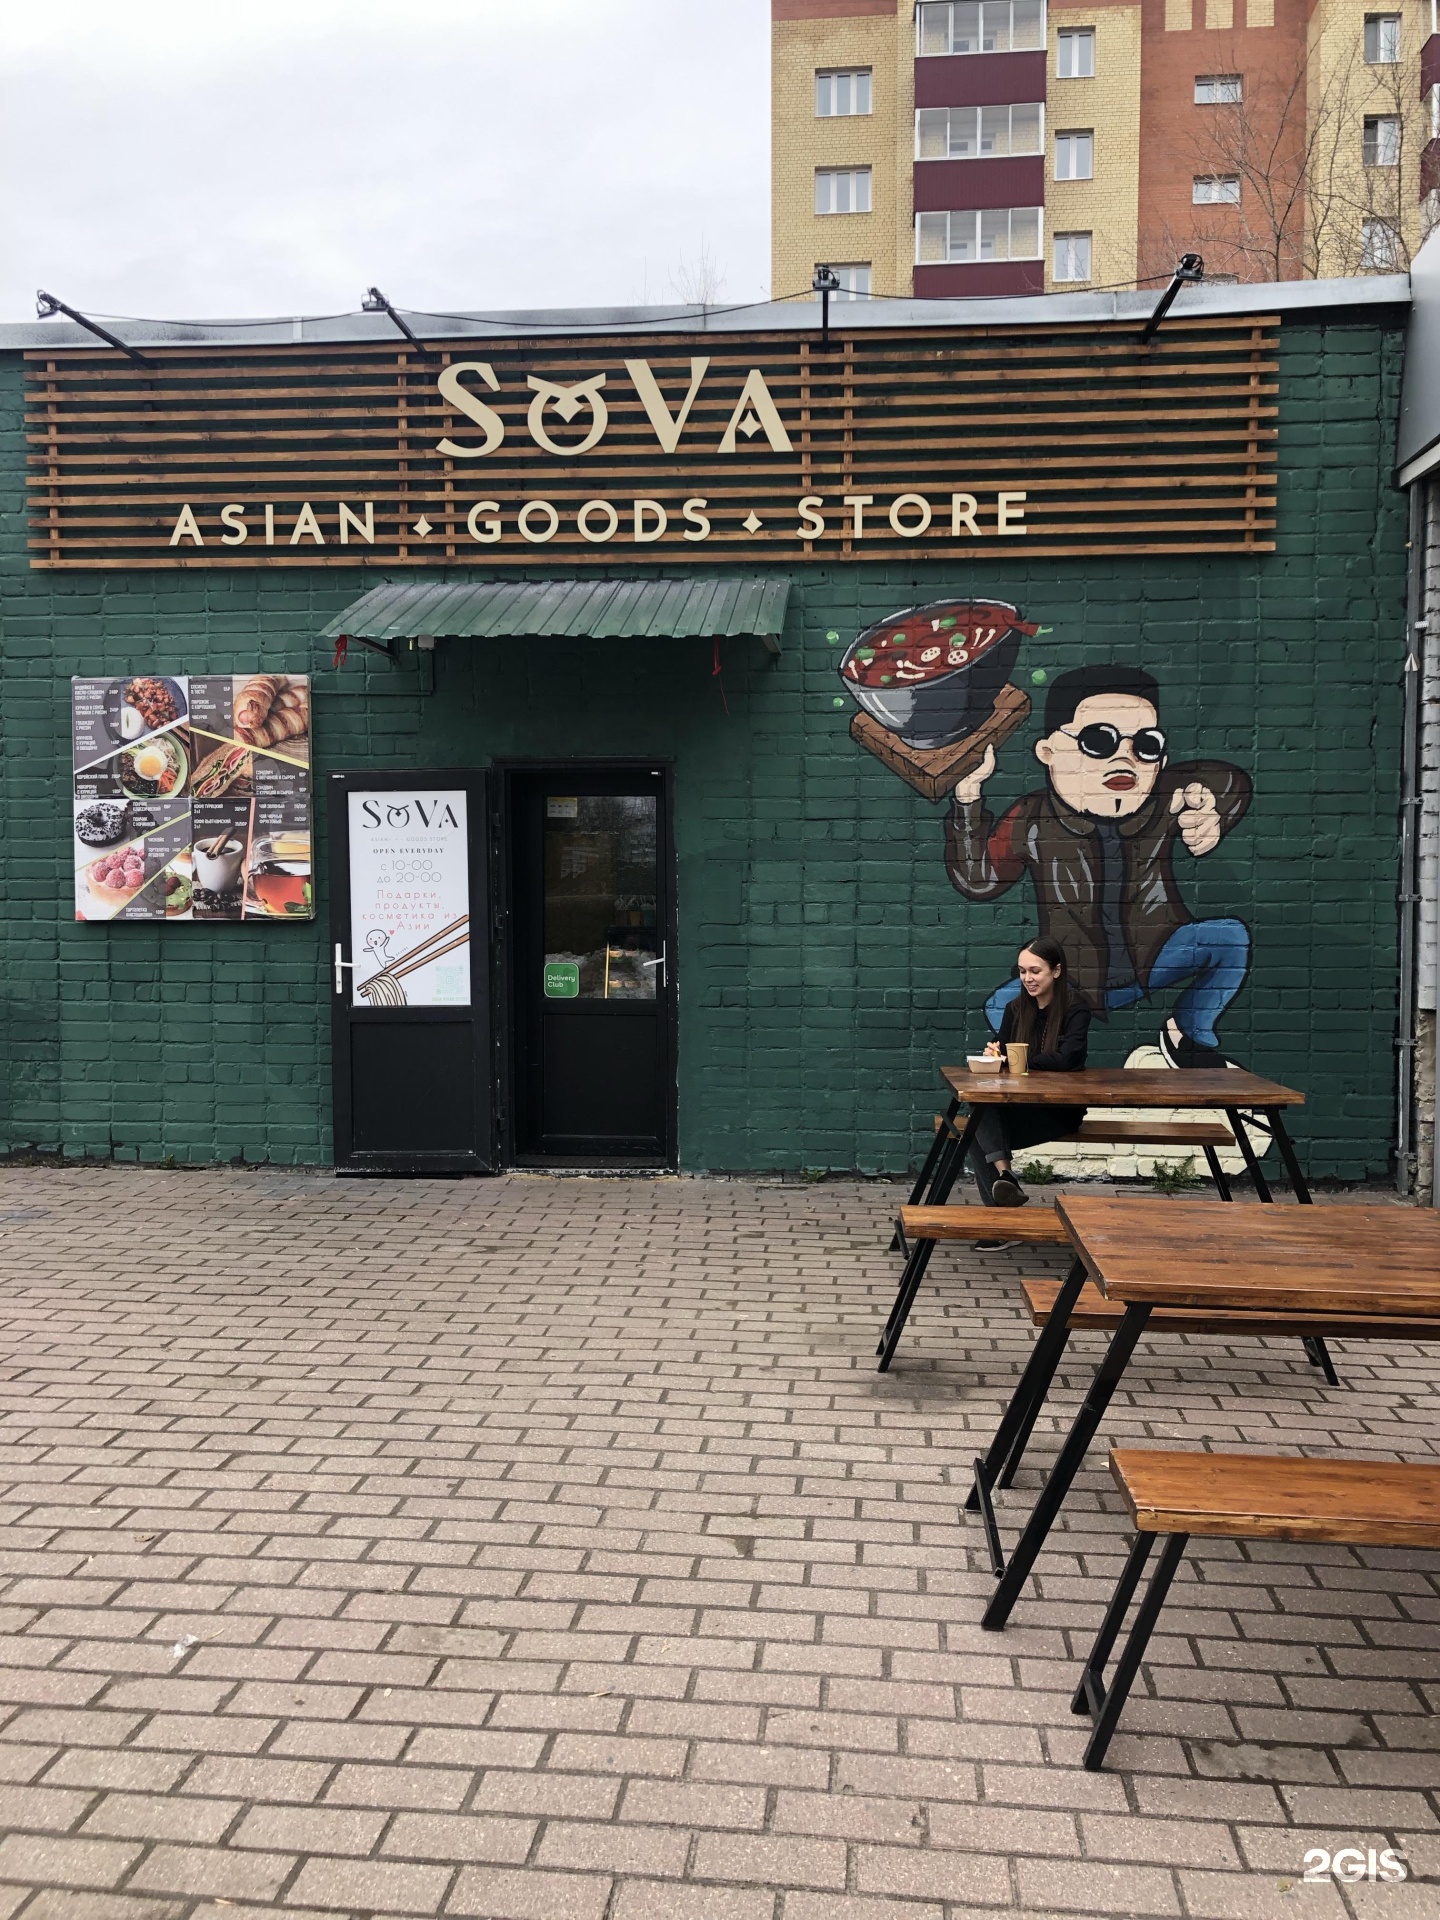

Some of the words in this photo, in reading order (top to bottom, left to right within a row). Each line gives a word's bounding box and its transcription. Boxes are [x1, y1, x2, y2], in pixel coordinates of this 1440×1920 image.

[436, 356, 794, 458] SOVA
[169, 501, 375, 546] ASIAN
[467, 498, 710, 544] GOODS
[796, 491, 1028, 540] STORE
[362, 800, 459, 828] SOVA
[391, 860, 433, 870] 10-00
[396, 872, 442, 883] 20-00
[397, 921, 429, 930] Азии
